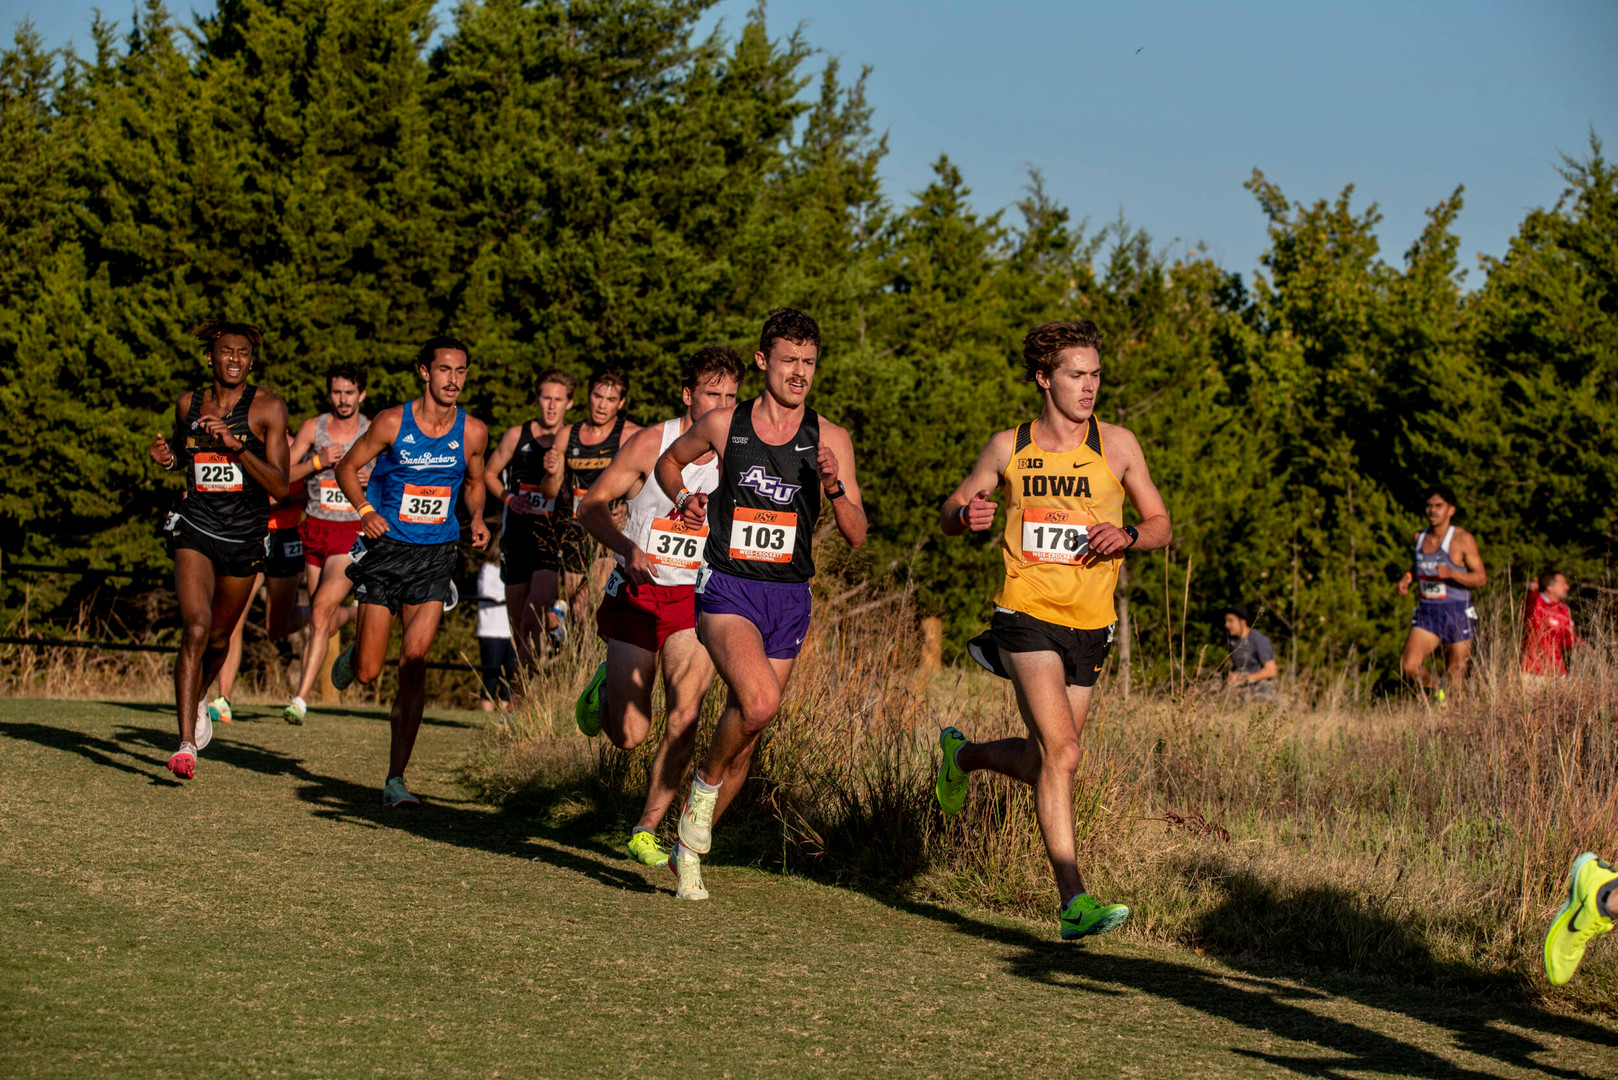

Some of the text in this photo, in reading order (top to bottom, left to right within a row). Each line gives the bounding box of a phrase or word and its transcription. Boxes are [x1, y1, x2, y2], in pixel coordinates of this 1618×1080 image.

[202, 466, 235, 482] 225
[738, 466, 801, 504] ACU
[326, 490, 349, 503] 26
[1022, 475, 1092, 498] IOWA
[408, 498, 443, 515] 352
[657, 534, 698, 558] 376
[742, 525, 785, 550] 103
[1033, 526, 1079, 552] 178
